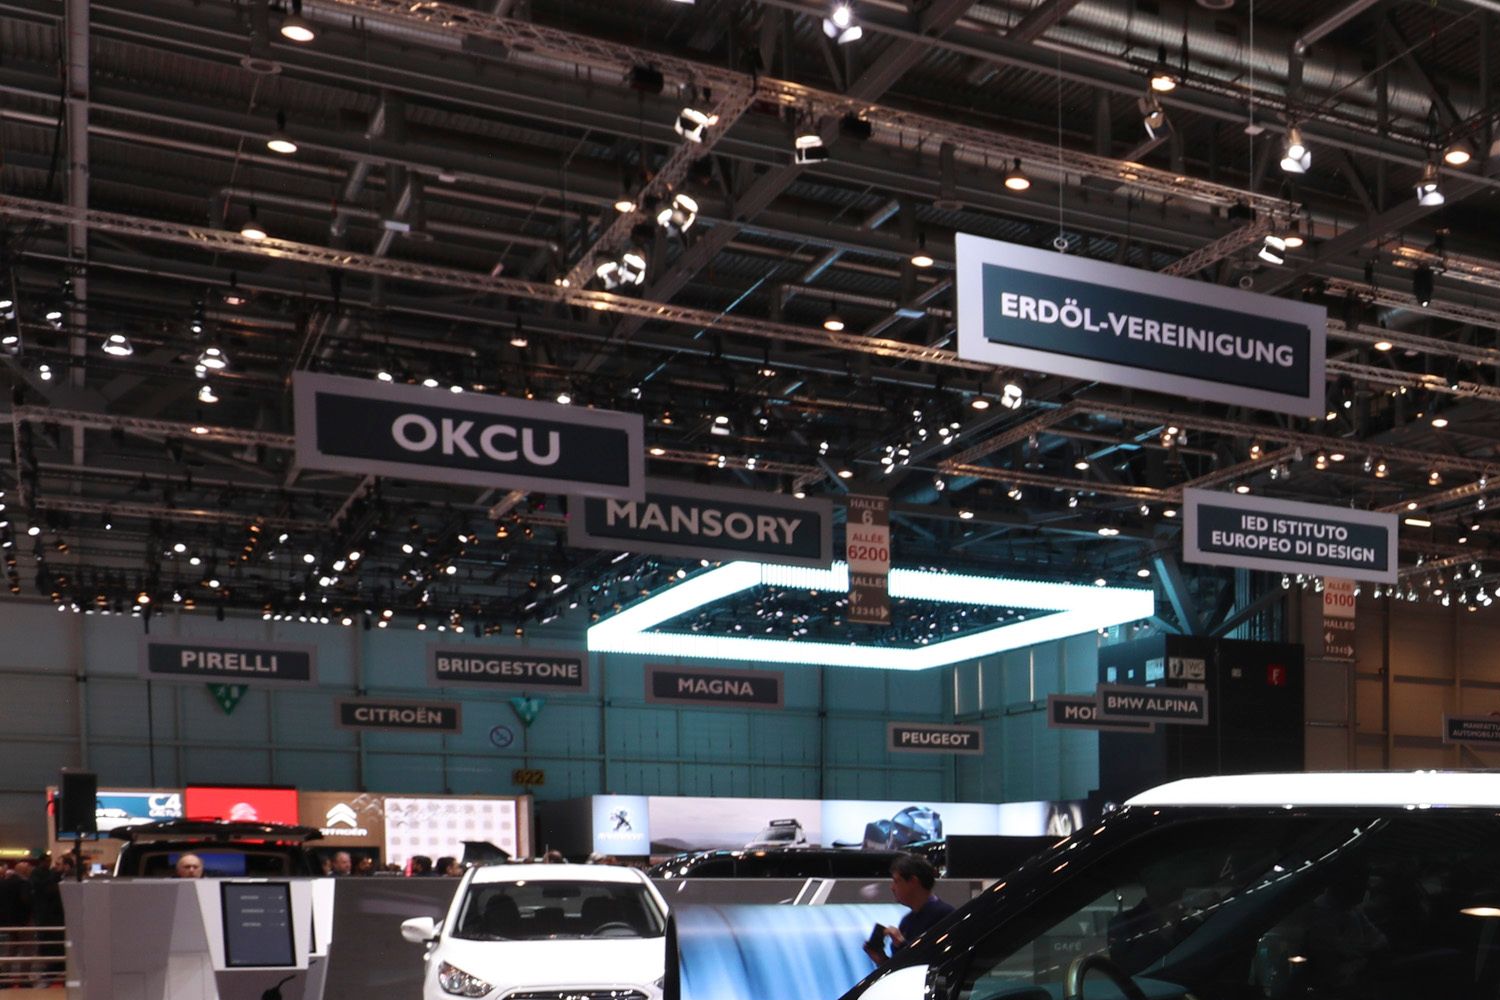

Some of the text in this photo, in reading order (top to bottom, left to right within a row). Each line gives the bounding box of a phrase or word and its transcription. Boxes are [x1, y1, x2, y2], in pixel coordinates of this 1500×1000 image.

[1001, 291, 1294, 367] ERDÖL-VEREINIGUNG
[391, 413, 560, 466] OKCU
[606, 499, 801, 545] MANSORY
[1241, 514, 1348, 542] IED ISTITUTO
[848, 545, 888, 562] 6200
[1211, 530, 1375, 563] EUROPEO DI DESIGN
[1325, 592, 1354, 607] 6100
[181, 650, 278, 672] PIRELLI
[437, 657, 579, 679] BRIDGESTONE
[678, 677, 754, 696] MAGNA
[354, 706, 442, 725] CITROËN
[1108, 696, 1199, 713] BMW ALPINA
[901, 731, 970, 746] PEUGEOT
